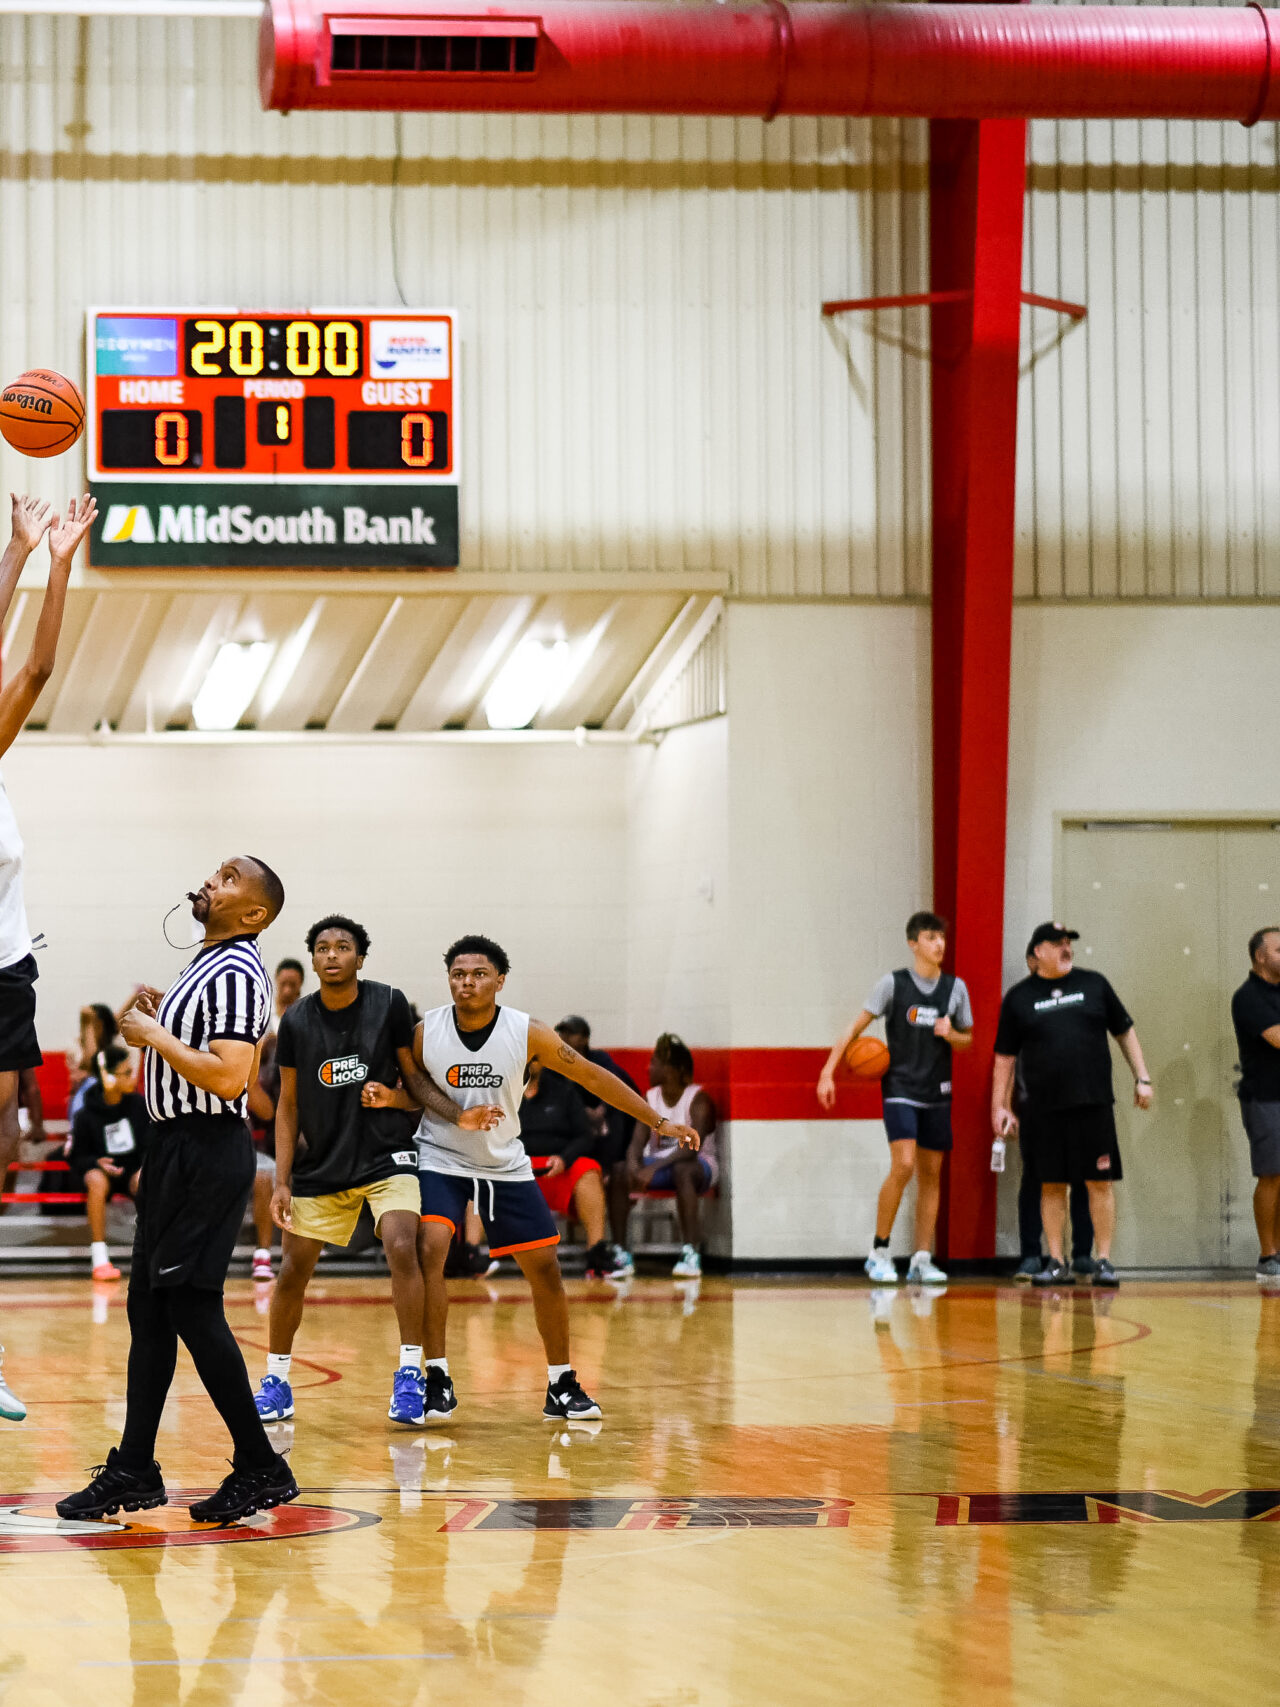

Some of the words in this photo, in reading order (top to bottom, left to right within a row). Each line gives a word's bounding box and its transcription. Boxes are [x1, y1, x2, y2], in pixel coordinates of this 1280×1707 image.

[191, 320, 359, 376] 20:00
[119, 381, 184, 404] HOME
[243, 380, 306, 398] PERIOD
[361, 382, 433, 405] GUEST
[2, 393, 52, 415] Wilson
[276, 405, 289, 440] 1
[155, 411, 188, 465] 0
[401, 412, 434, 466] 0
[158, 506, 337, 544] MidSouth
[343, 507, 436, 545] Bank
[459, 1076, 501, 1087] HOOPS
[460, 1065, 490, 1075] PREP
